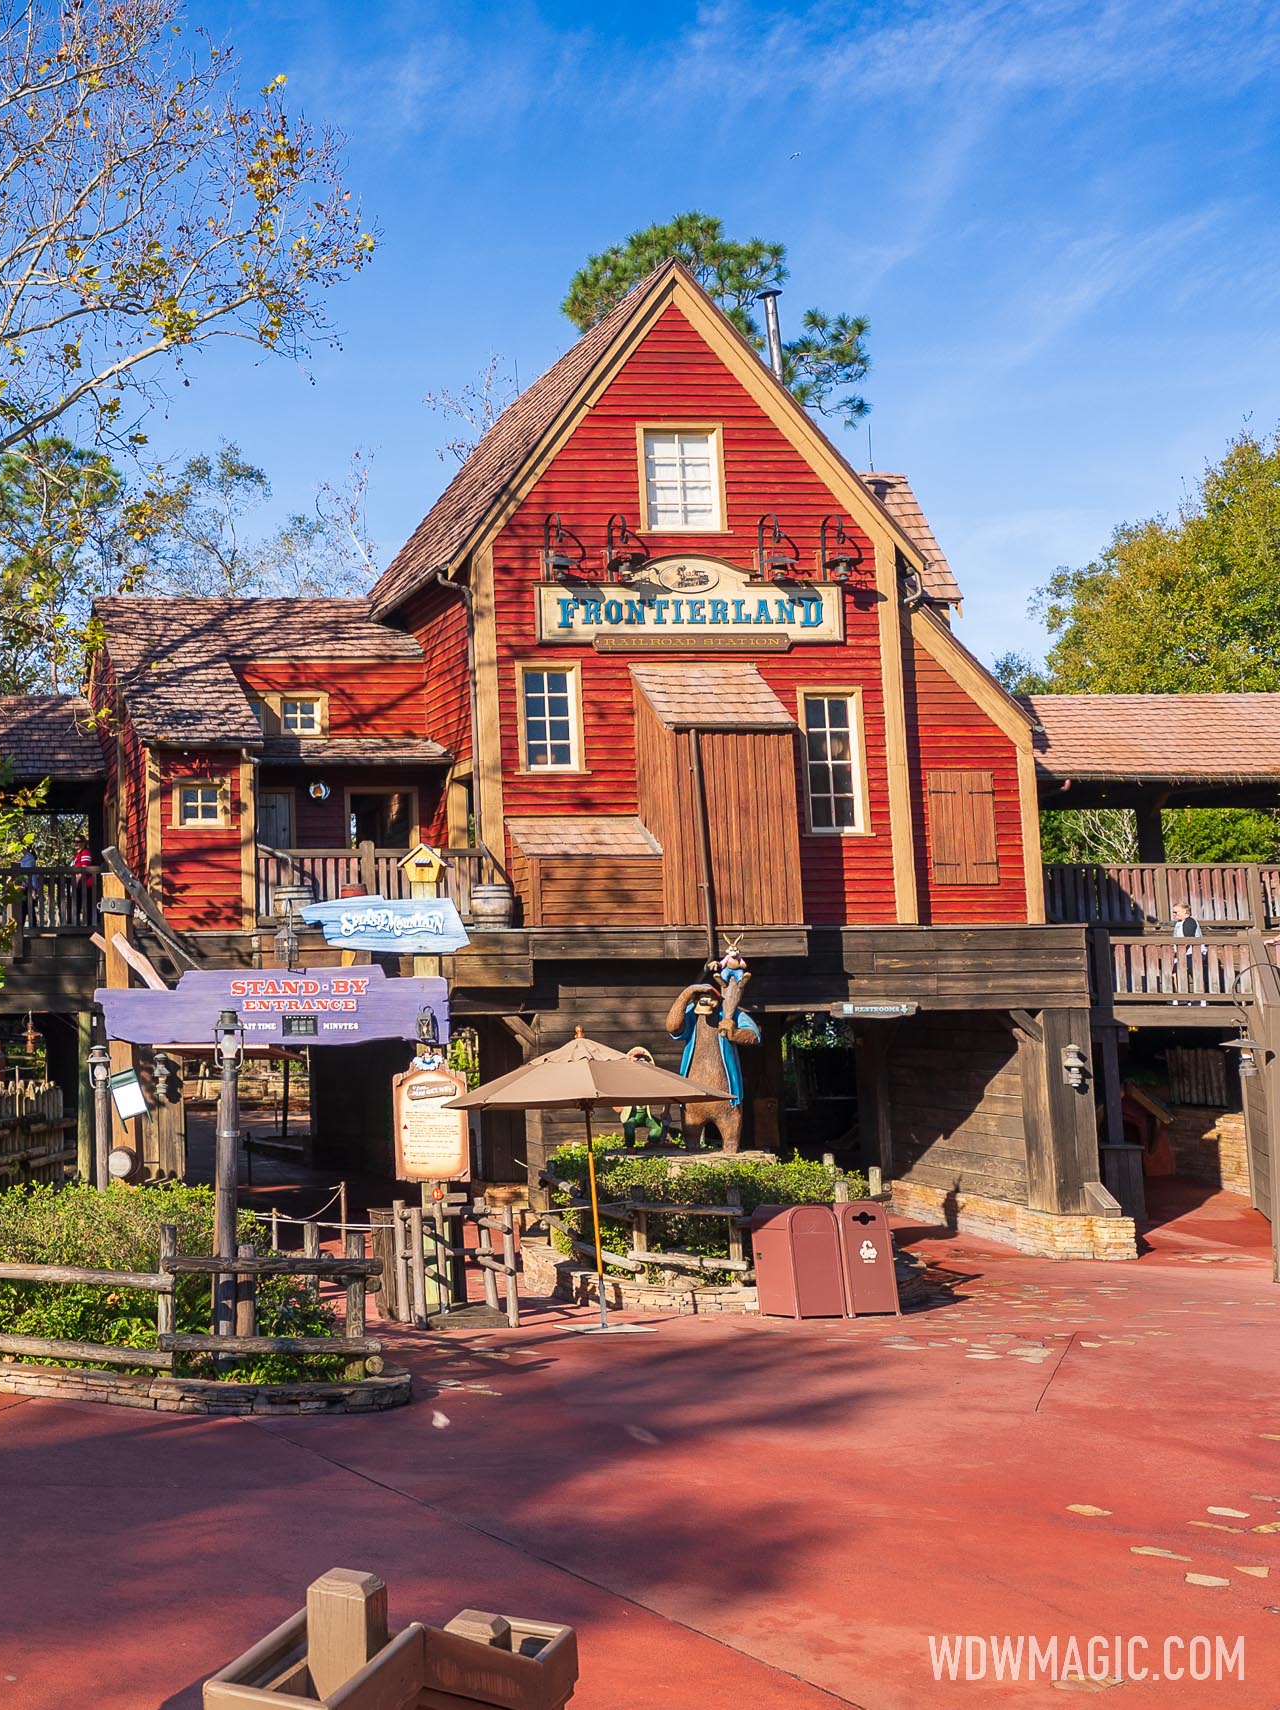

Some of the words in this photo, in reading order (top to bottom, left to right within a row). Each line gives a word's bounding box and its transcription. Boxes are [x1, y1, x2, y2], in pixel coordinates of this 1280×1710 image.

[557, 597, 824, 628] FRONTIERLAND
[603, 636, 696, 646] RAILROAD
[703, 636, 781, 646] STATION
[243, 999, 359, 1012] ENTRANCE
[243, 1022, 257, 1030] AIT
[257, 1022, 277, 1030] TIME
[323, 1022, 359, 1030] MINUTES
